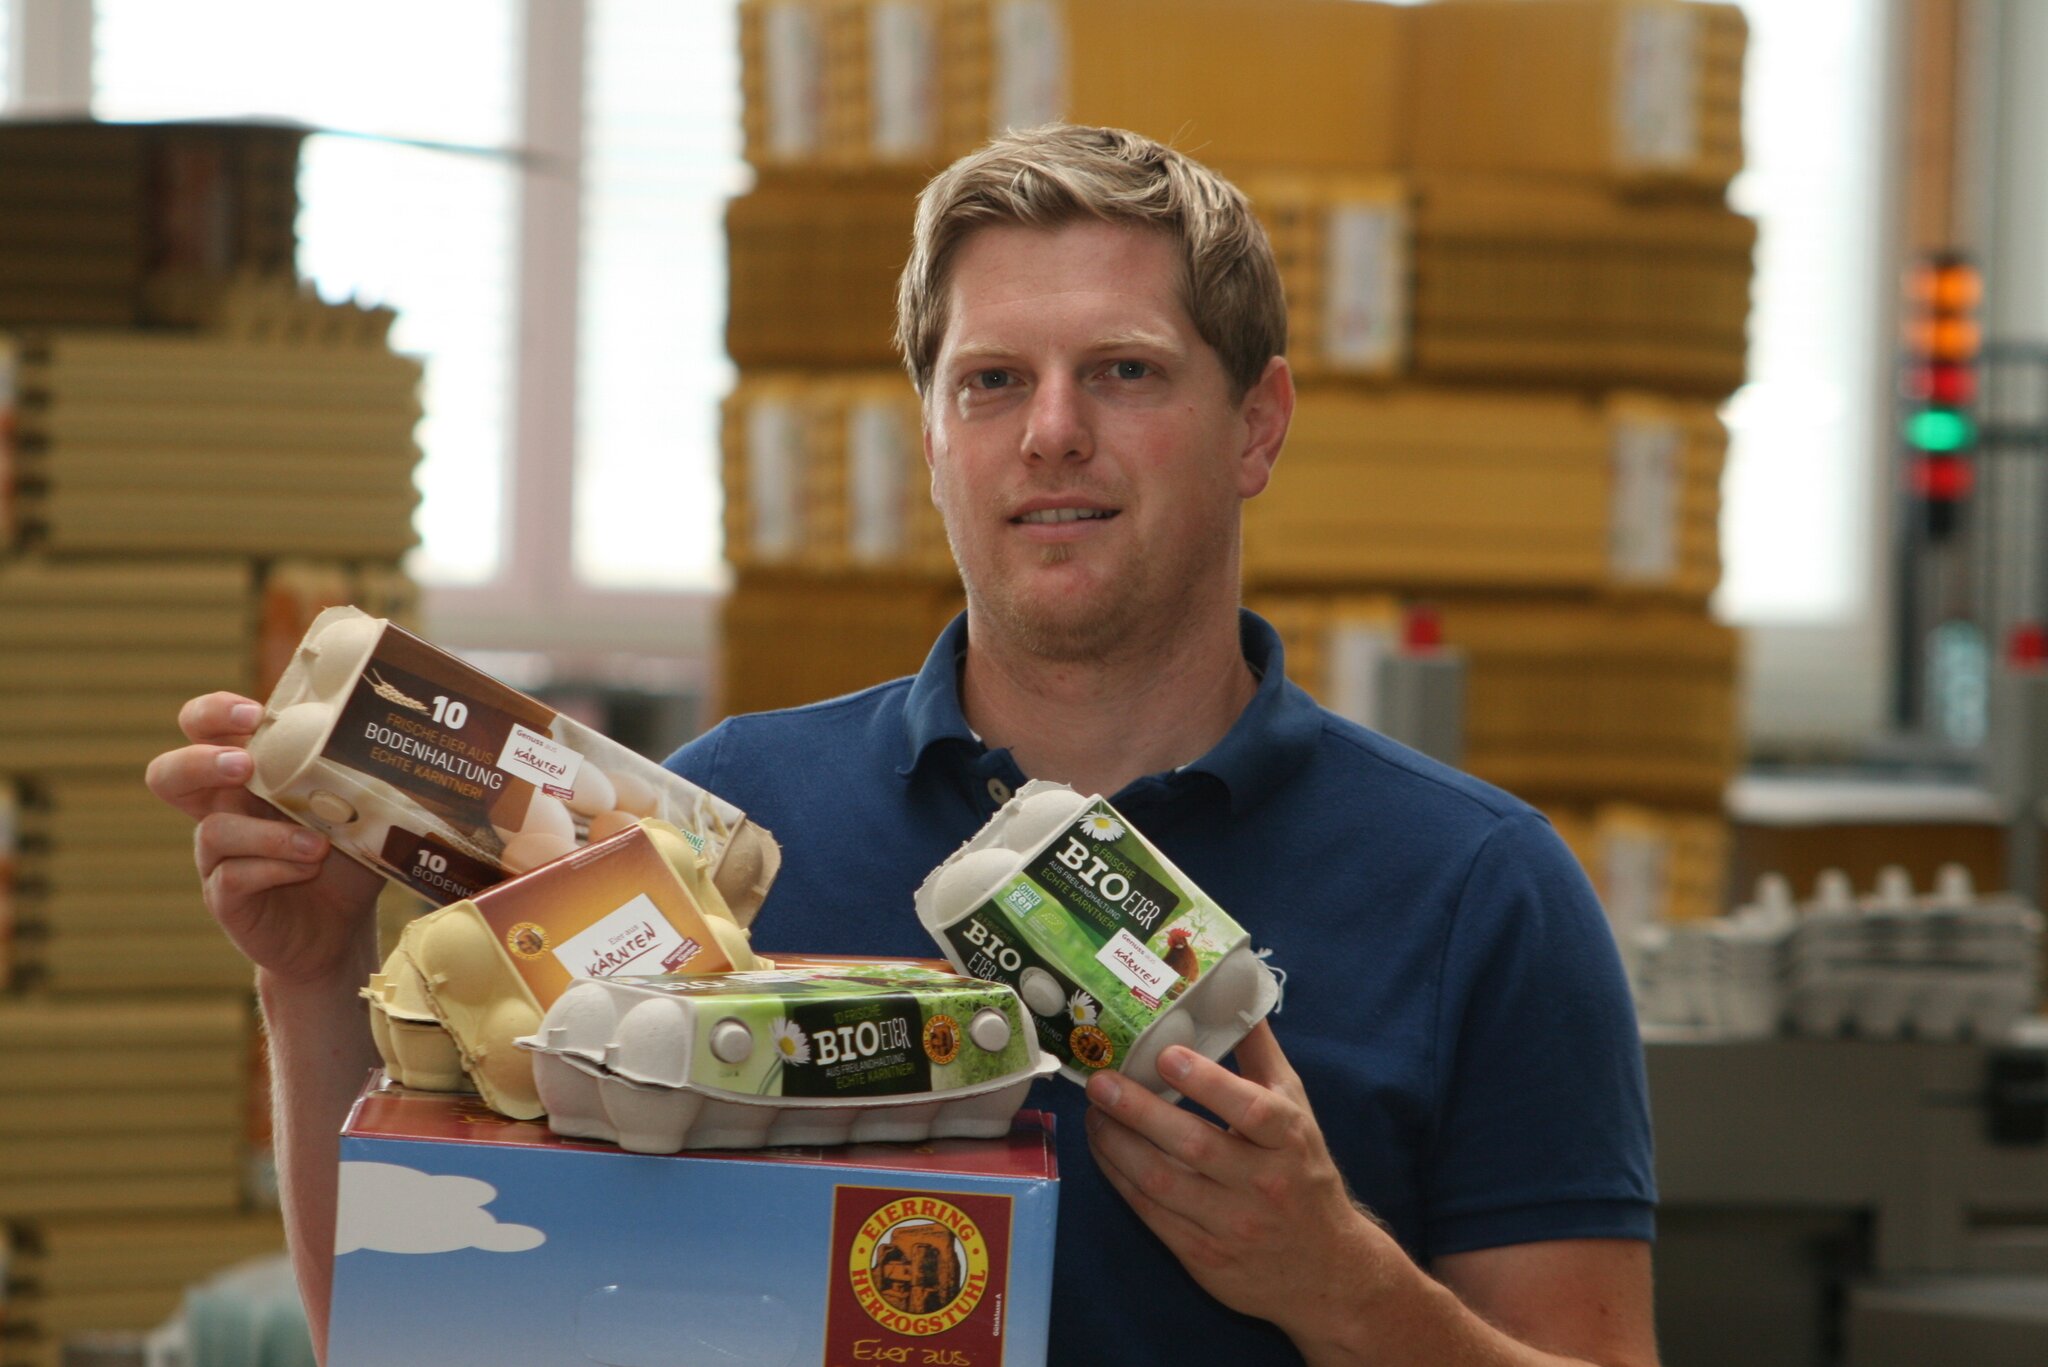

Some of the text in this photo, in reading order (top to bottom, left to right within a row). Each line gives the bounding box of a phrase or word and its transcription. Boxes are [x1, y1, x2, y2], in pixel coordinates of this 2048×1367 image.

[432, 695, 468, 730] 10
[387, 713, 494, 766] FRISCHE EIER AUS
[517, 729, 544, 747] Genuss
[365, 722, 503, 790] BODENHALTUNG
[369, 746, 411, 773] ECHTE
[418, 850, 447, 873] 10
[1055, 835, 1130, 901] BIO
[1092, 843, 1137, 880] 6 FRISCHE
[1019, 884, 1041, 904] OHNE
[1041, 867, 1071, 895] ECHTE
[1048, 860, 1063, 874] AUS
[1062, 869, 1121, 920] FREILANDHALTUNG
[1009, 891, 1033, 911] gen
[608, 932, 625, 945] Eier
[963, 918, 1022, 972] BIO
[1121, 933, 1145, 955] Genuss
[812, 1018, 912, 1066] BIO EIER
[826, 1053, 906, 1078] AUS FREILANDHALTUNG
[836, 1073, 866, 1089] ECHTE
[861, 1199, 976, 1242] EIERRING
[851, 1268, 986, 1335] HERZOGSTUHL
[853, 1338, 971, 1366] Eier aus
